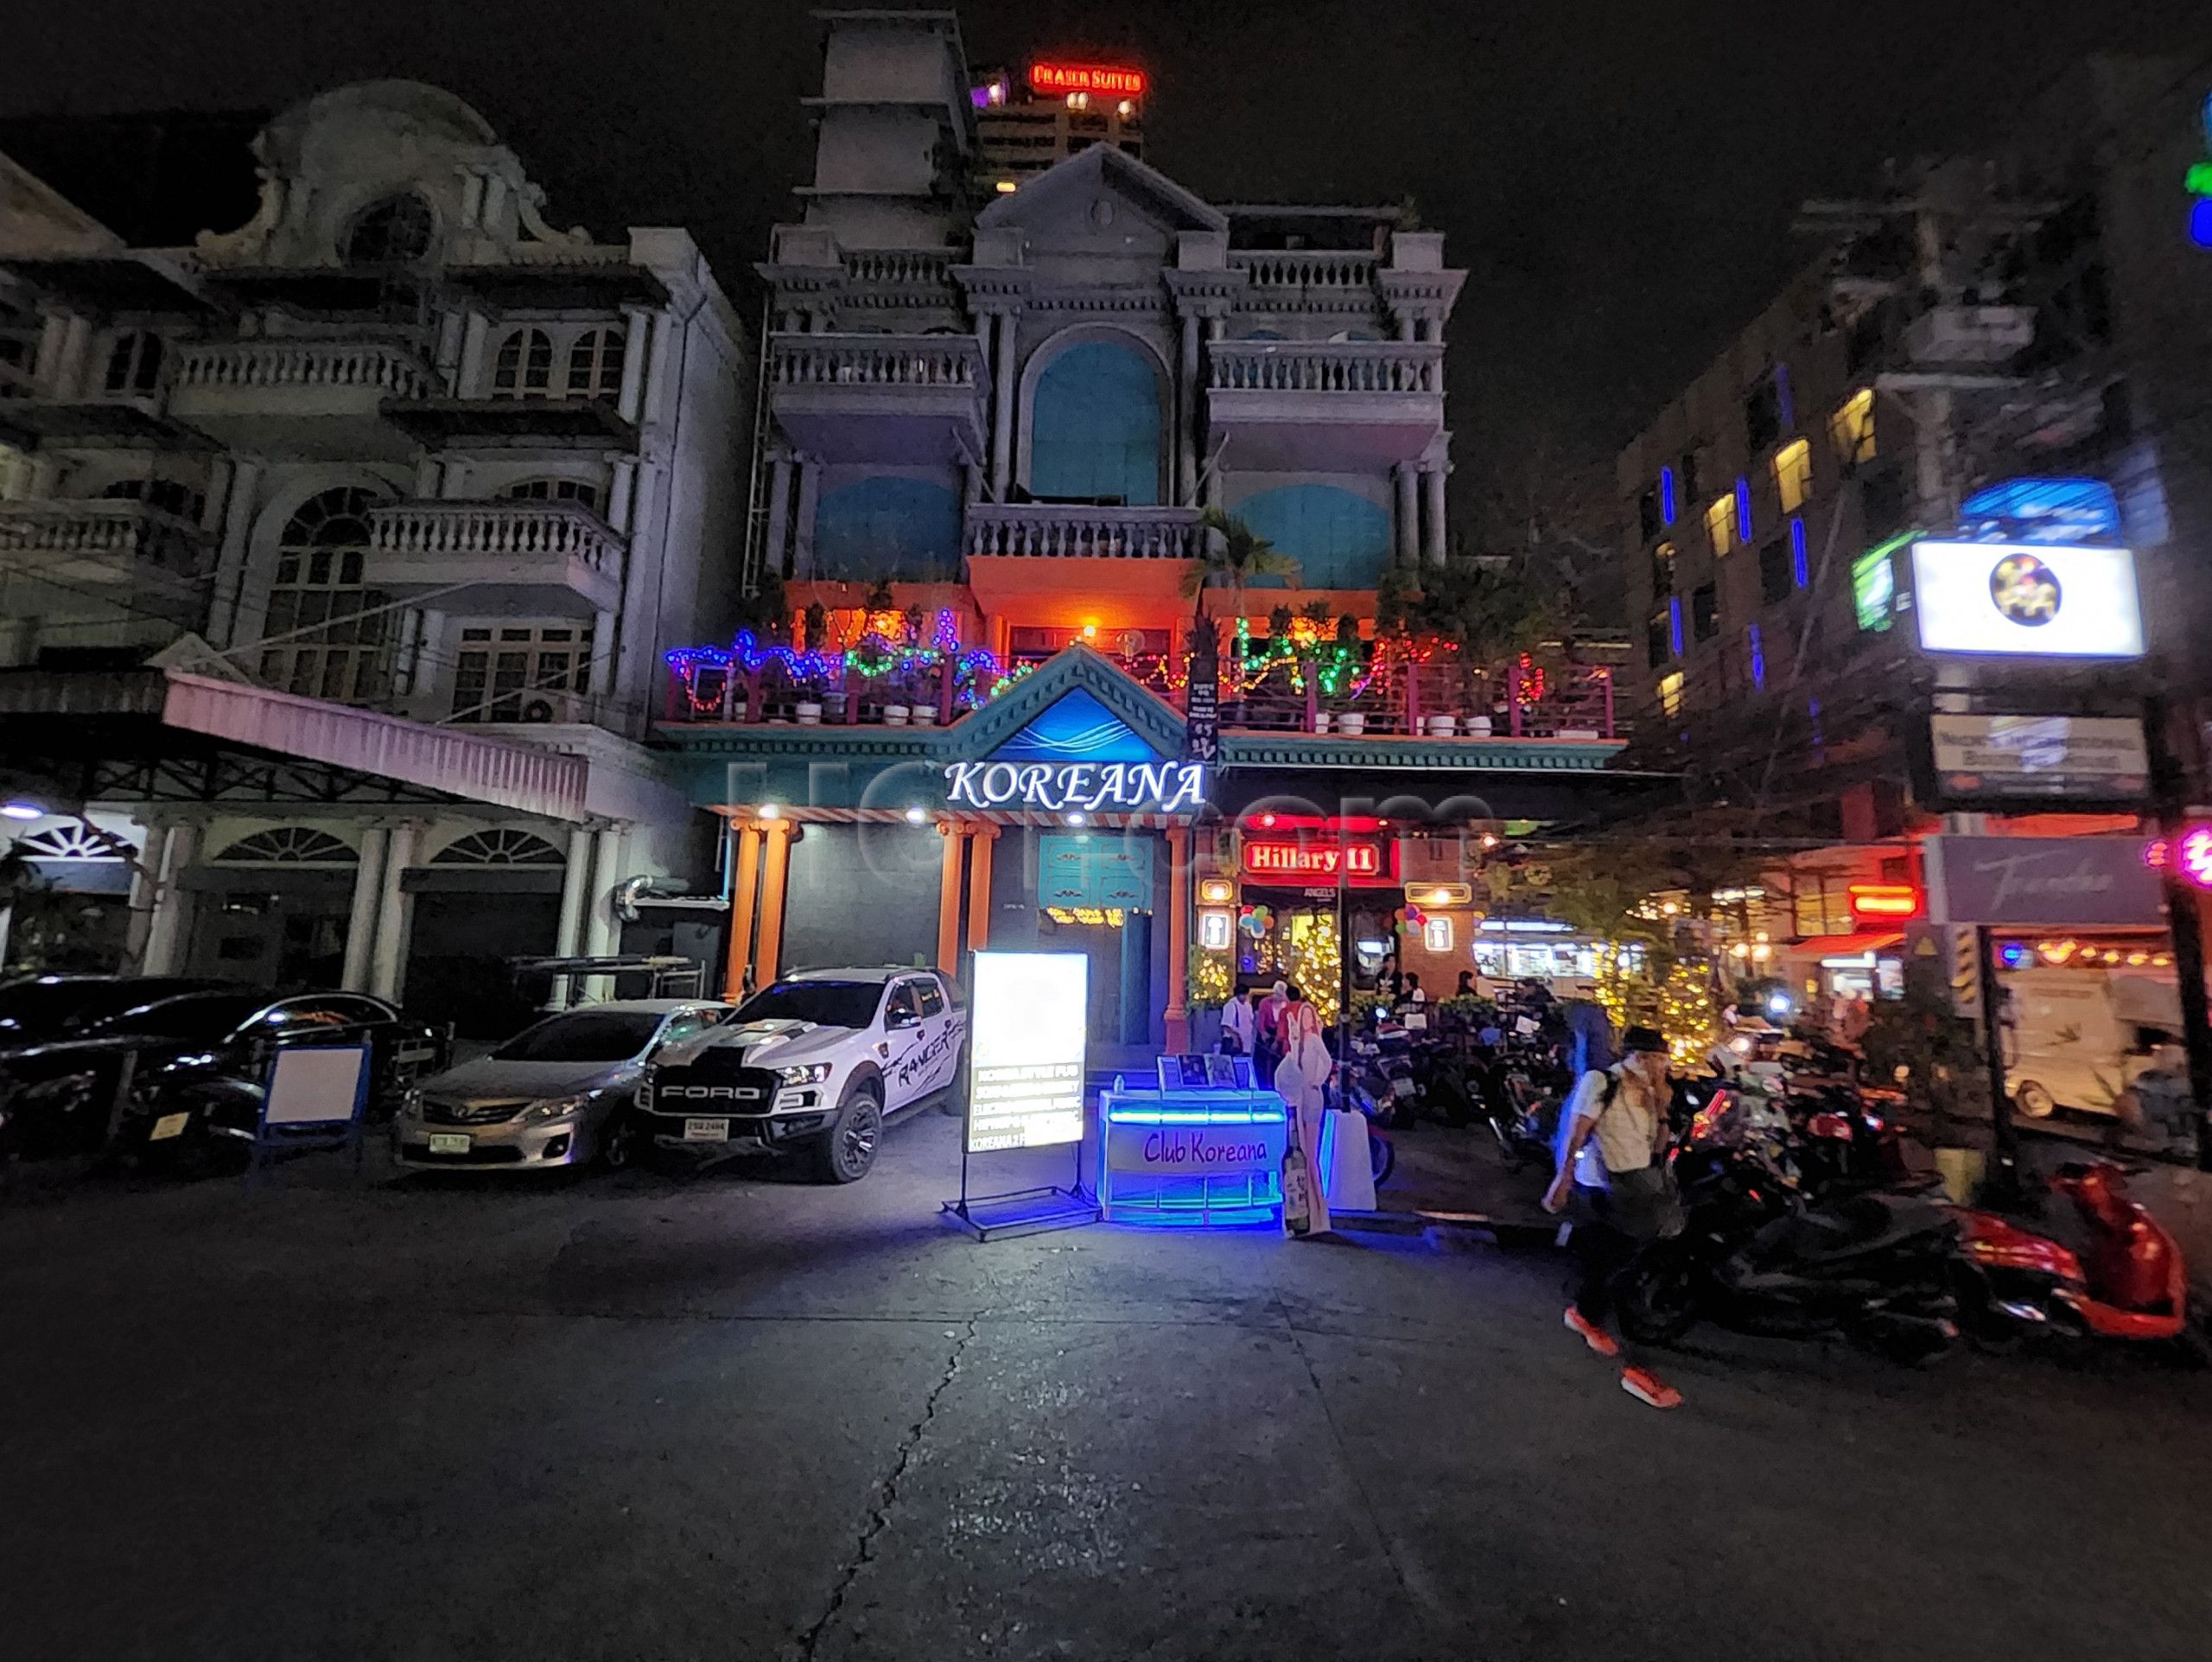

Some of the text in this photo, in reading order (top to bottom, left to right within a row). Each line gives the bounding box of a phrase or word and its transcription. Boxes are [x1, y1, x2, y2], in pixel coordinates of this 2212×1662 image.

[944, 761, 1205, 812] KOREANA
[1250, 846, 1339, 872] Hillary
[661, 1086, 760, 1099] FORD
[1144, 1130, 1267, 1163] Club Koreana
